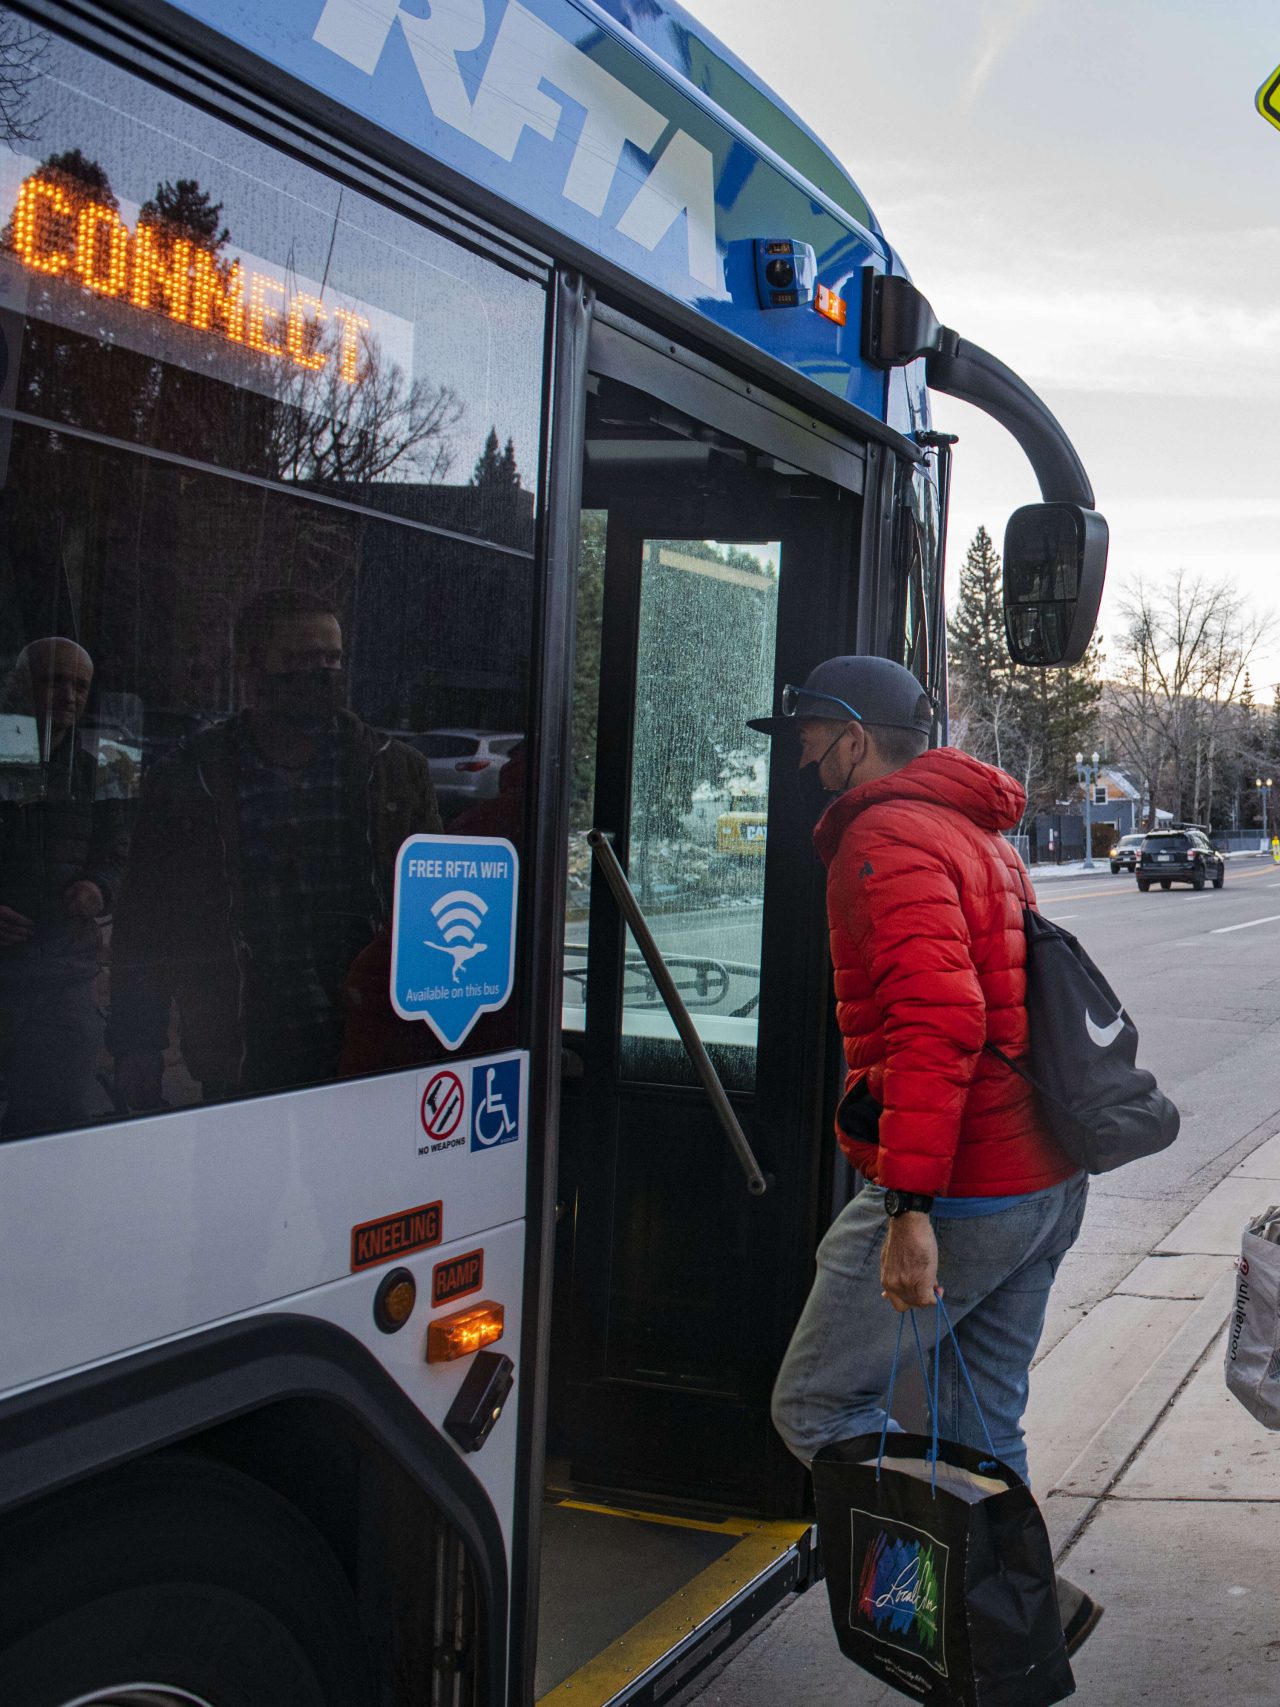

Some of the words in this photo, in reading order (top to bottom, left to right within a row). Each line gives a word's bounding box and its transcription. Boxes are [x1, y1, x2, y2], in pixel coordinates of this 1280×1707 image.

[312, 0, 720, 291] RFTA
[11, 172, 370, 385] CONNECT
[408, 859, 443, 878] FREE
[445, 860, 478, 879] RFTA
[480, 861, 508, 879] WIFI
[405, 984, 449, 1003] Available
[451, 988, 463, 998] on
[465, 984, 481, 997] this
[483, 982, 499, 995] bus
[418, 1146, 429, 1156] NO
[430, 1136, 466, 1153] WEAPONS
[357, 1210, 437, 1262] KNEELING
[436, 1260, 480, 1296] RAMP
[1230, 1279, 1251, 1361] lululemon
